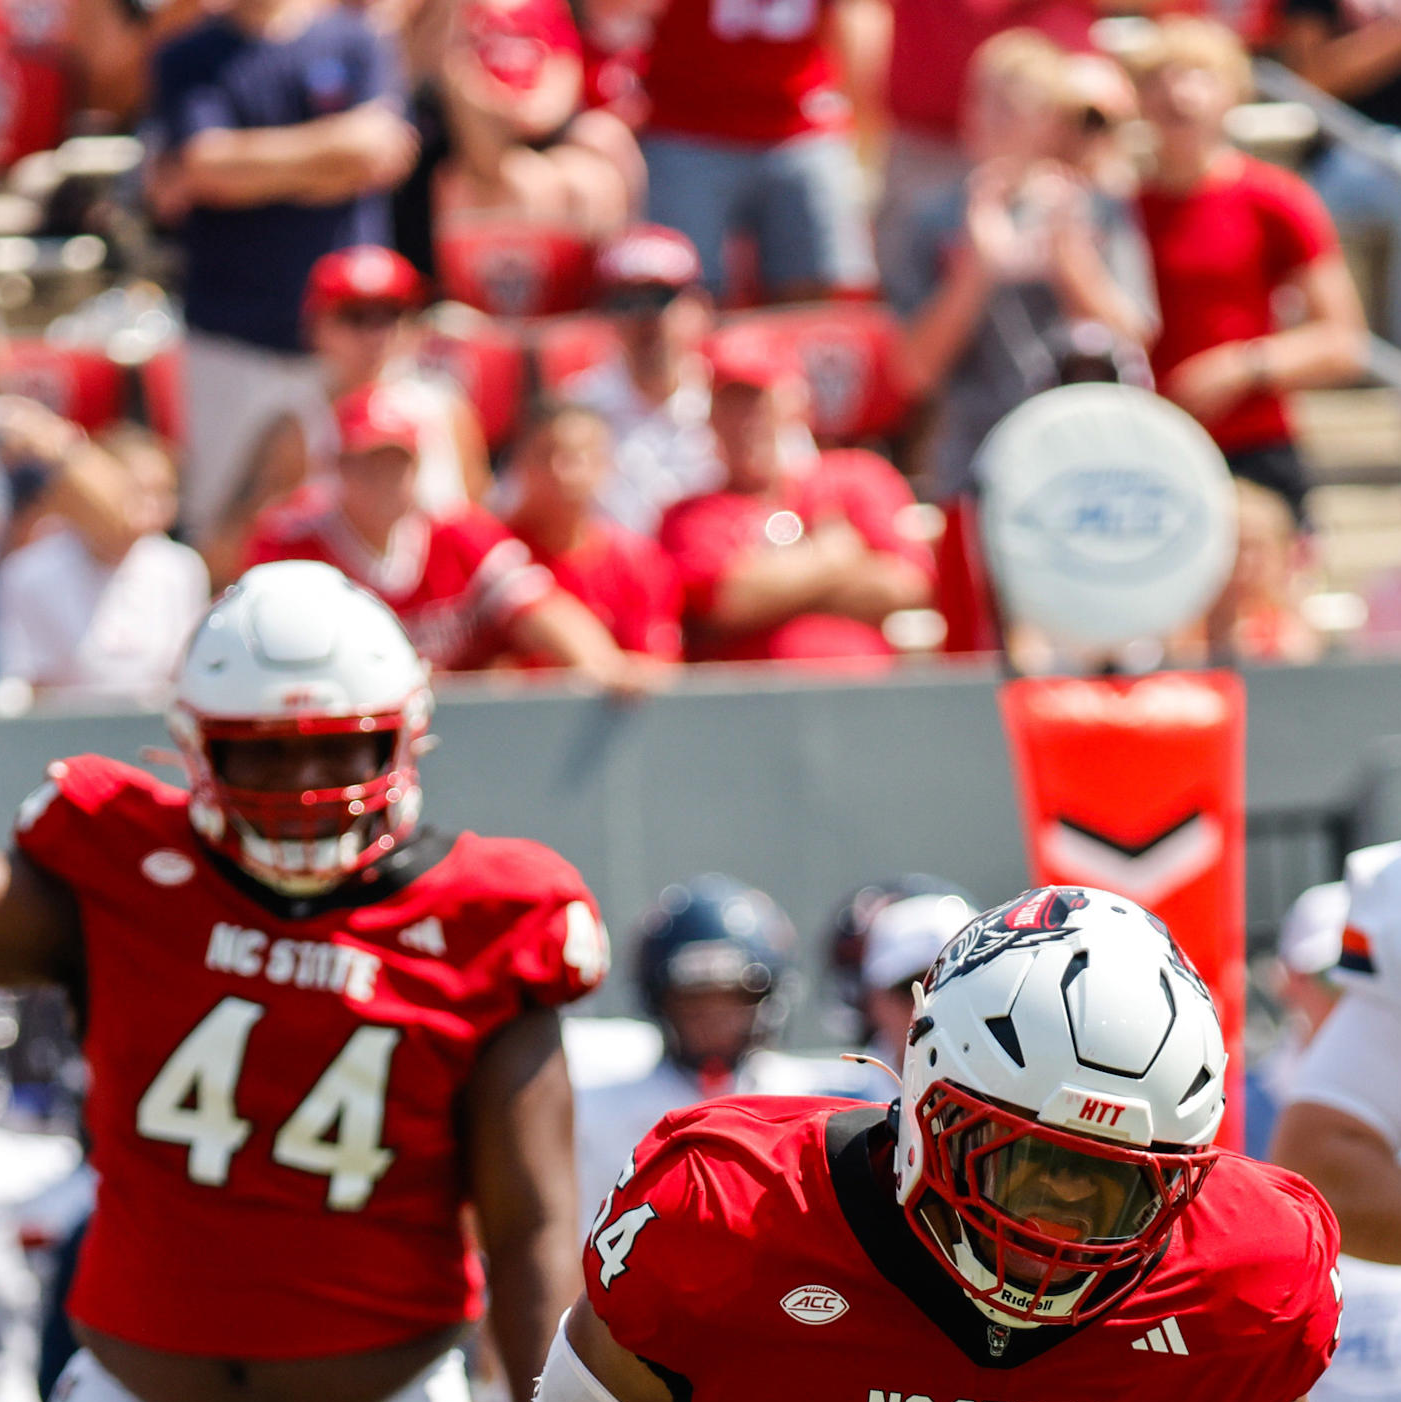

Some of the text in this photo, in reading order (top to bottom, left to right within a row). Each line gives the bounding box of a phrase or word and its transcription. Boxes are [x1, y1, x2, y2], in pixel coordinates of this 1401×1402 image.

[205, 920, 382, 1003] NC STATE
[135, 994, 403, 1214] 44
[1078, 1097, 1126, 1127] HTT
[791, 1295, 839, 1310] ACC
